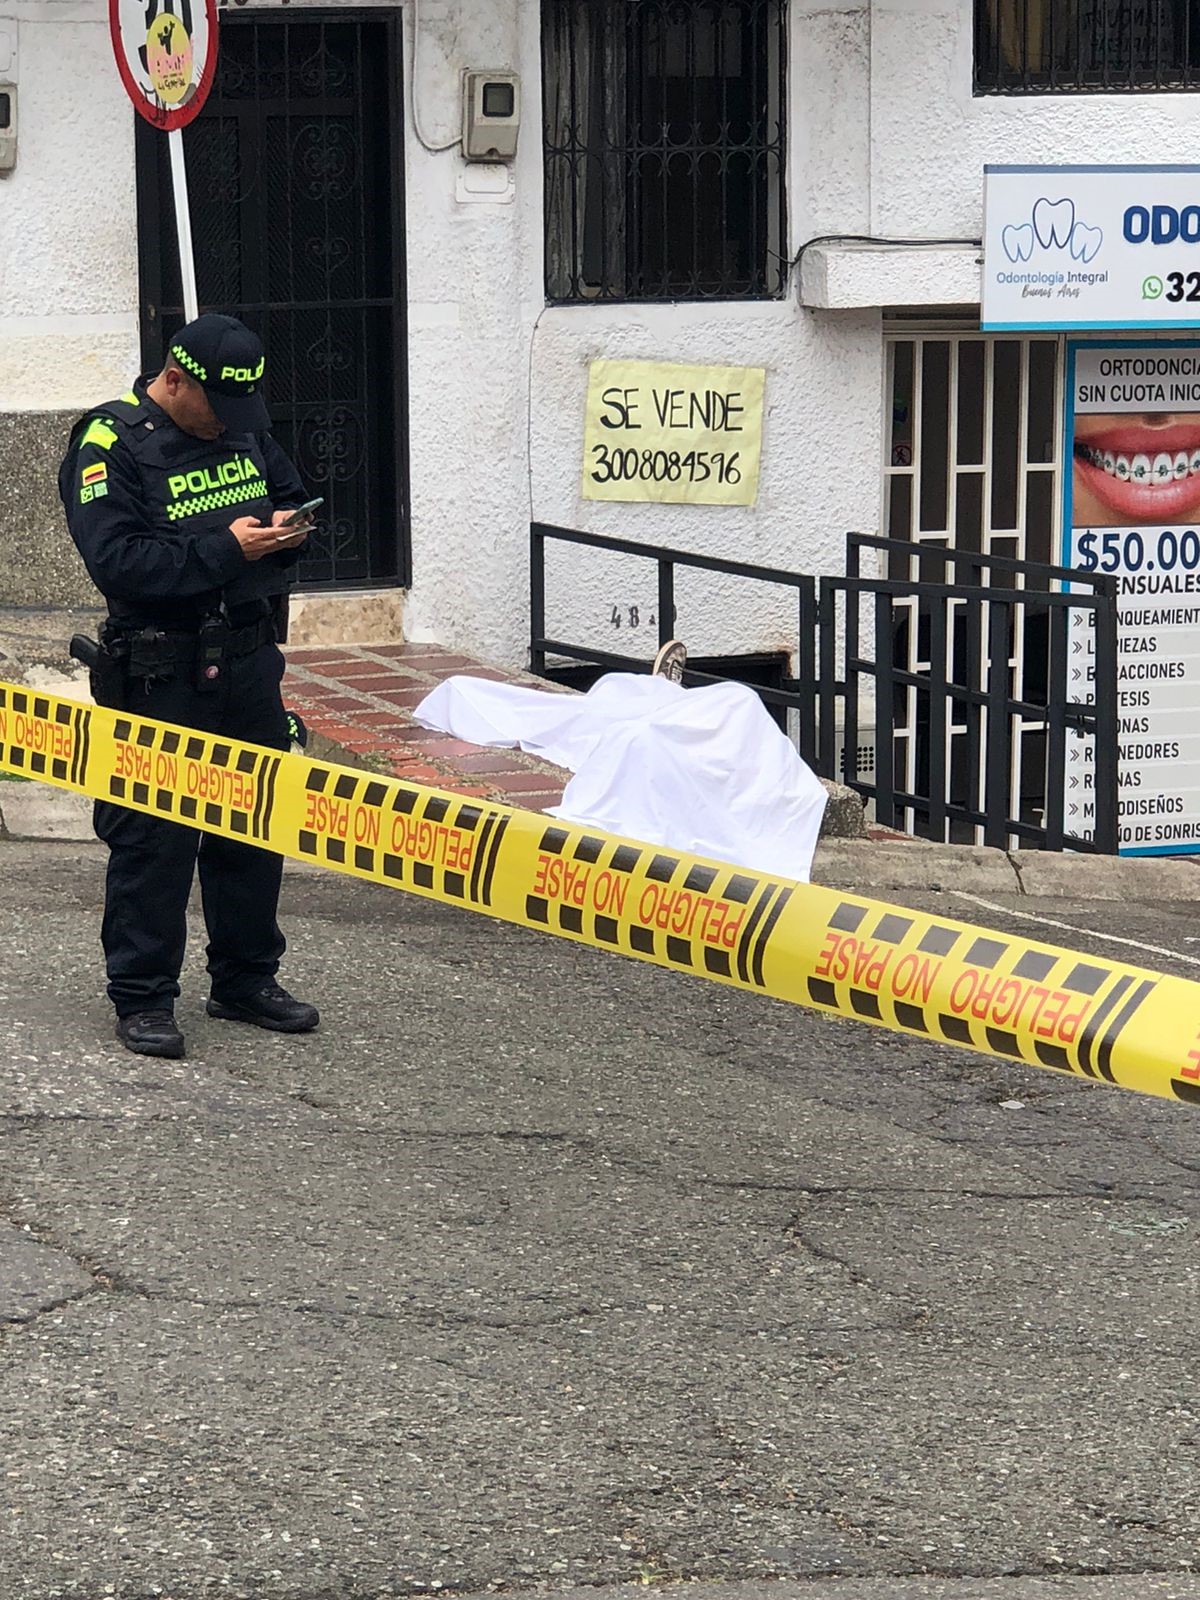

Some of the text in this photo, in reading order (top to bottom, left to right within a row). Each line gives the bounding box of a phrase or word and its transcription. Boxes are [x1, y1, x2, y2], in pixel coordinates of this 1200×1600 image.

[1123, 205, 1200, 245] ODO
[1067, 270, 1108, 285] Integral
[1166, 271, 1200, 302] 32
[600, 387, 744, 431] SE VENDE
[1079, 385, 1105, 402] SIN
[1110, 384, 1165, 402] CUOTA
[168, 453, 260, 498] POLICÍA
[591, 444, 741, 484] 3008084596
[15, 714, 72, 758] PELIGRO
[115, 742, 254, 810] PELIGRO NO PASE
[305, 793, 475, 871] PELIGRO NO PASE
[1135, 826, 1152, 842] DE
[533, 855, 746, 948] PELIGRO NO PASE
[815, 933, 1092, 1043] PELIGRO NO PASE
